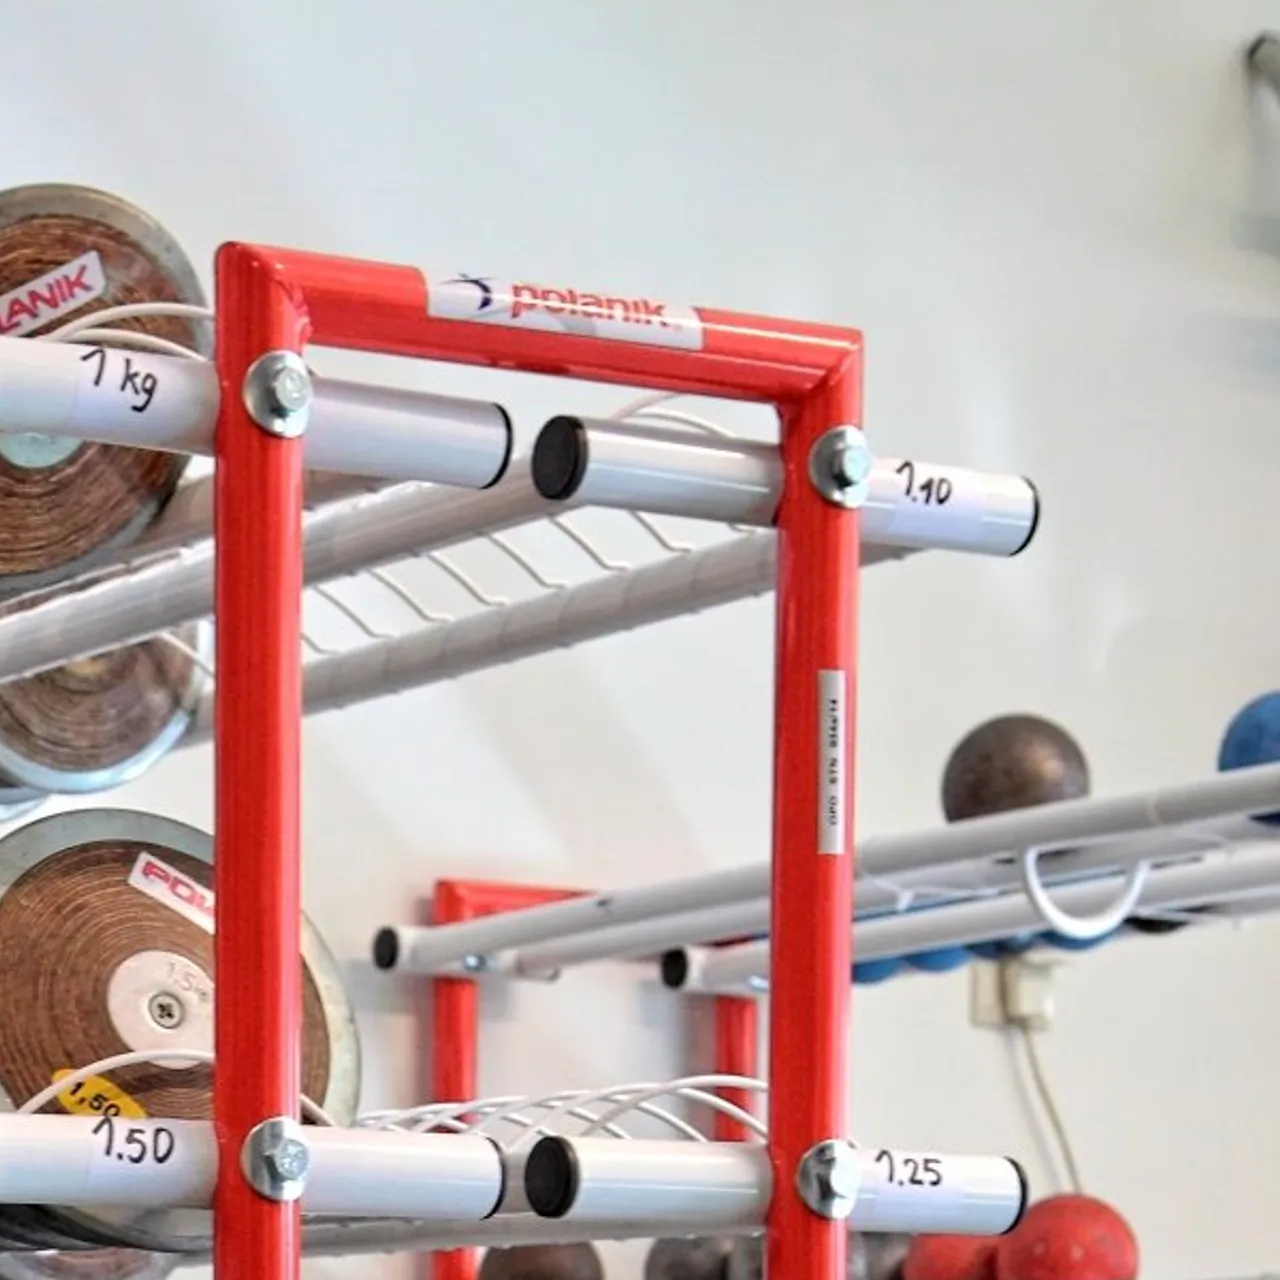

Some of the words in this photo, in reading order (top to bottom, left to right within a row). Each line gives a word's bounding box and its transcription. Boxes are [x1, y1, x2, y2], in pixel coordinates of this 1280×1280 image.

[511, 281, 676, 328] polanik
[80, 347, 107, 388] 1
[119, 357, 159, 413] kg
[895, 460, 953, 505] 1.10
[91, 1115, 175, 1164] 1.50
[874, 1149, 942, 1187] 1.25
